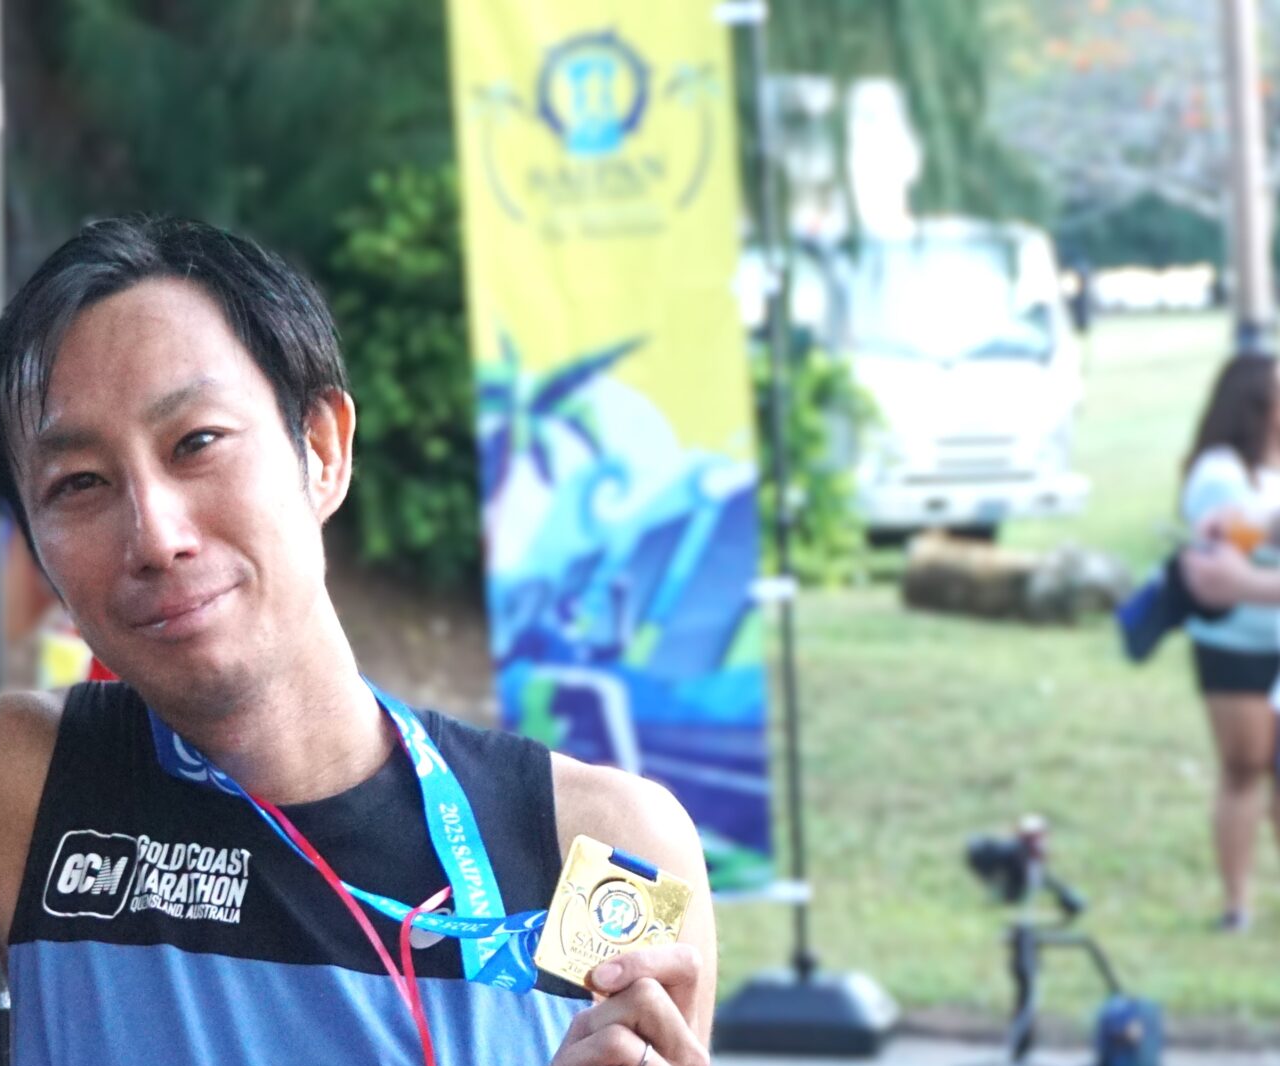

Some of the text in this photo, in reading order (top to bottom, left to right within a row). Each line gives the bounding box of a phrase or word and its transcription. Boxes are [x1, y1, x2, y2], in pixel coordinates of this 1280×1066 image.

[439, 802, 466, 849] 2025
[57, 853, 128, 895] GCM
[137, 834, 252, 877] GOLD COAST
[451, 845, 491, 918] SAIPAN
[186, 904, 240, 923] AUSTRALIA
